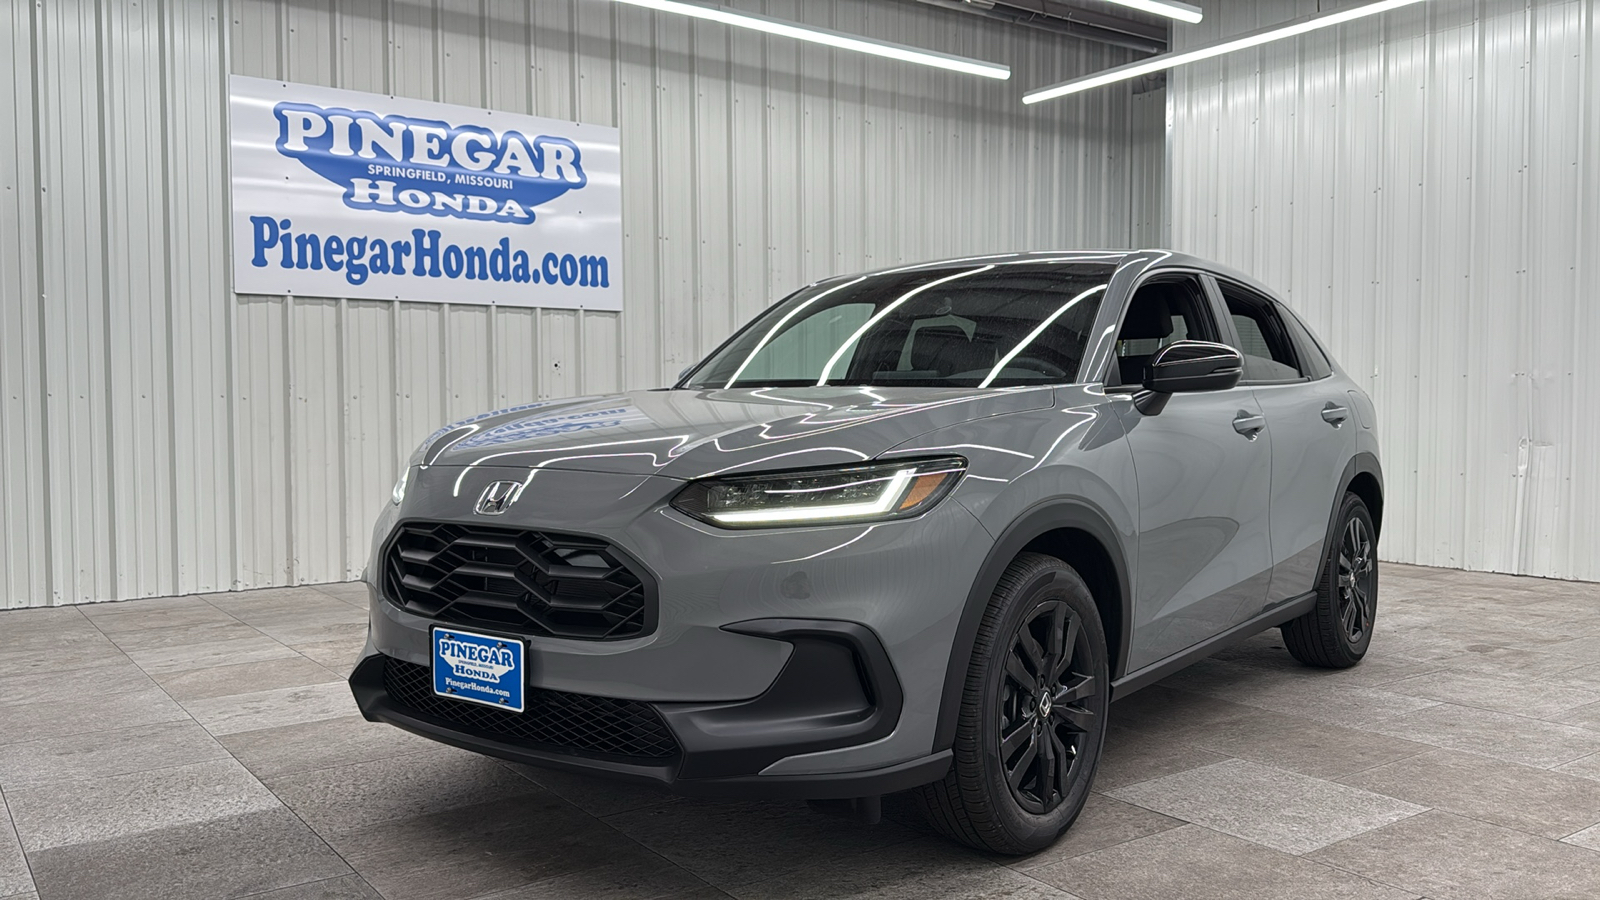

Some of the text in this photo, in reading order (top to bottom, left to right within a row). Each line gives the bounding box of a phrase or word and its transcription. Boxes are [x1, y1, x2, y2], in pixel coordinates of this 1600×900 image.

[281, 109, 581, 183] PINEGAR
[367, 163, 514, 190] SPRINGFIELD, MISSOURI
[350, 178, 529, 218] HONDA
[249, 215, 610, 288] PinegarHonda.com
[440, 641, 513, 668] PINEGAR
[454, 665, 499, 681] HONDA
[445, 677, 510, 697] PinegarHonda.com
